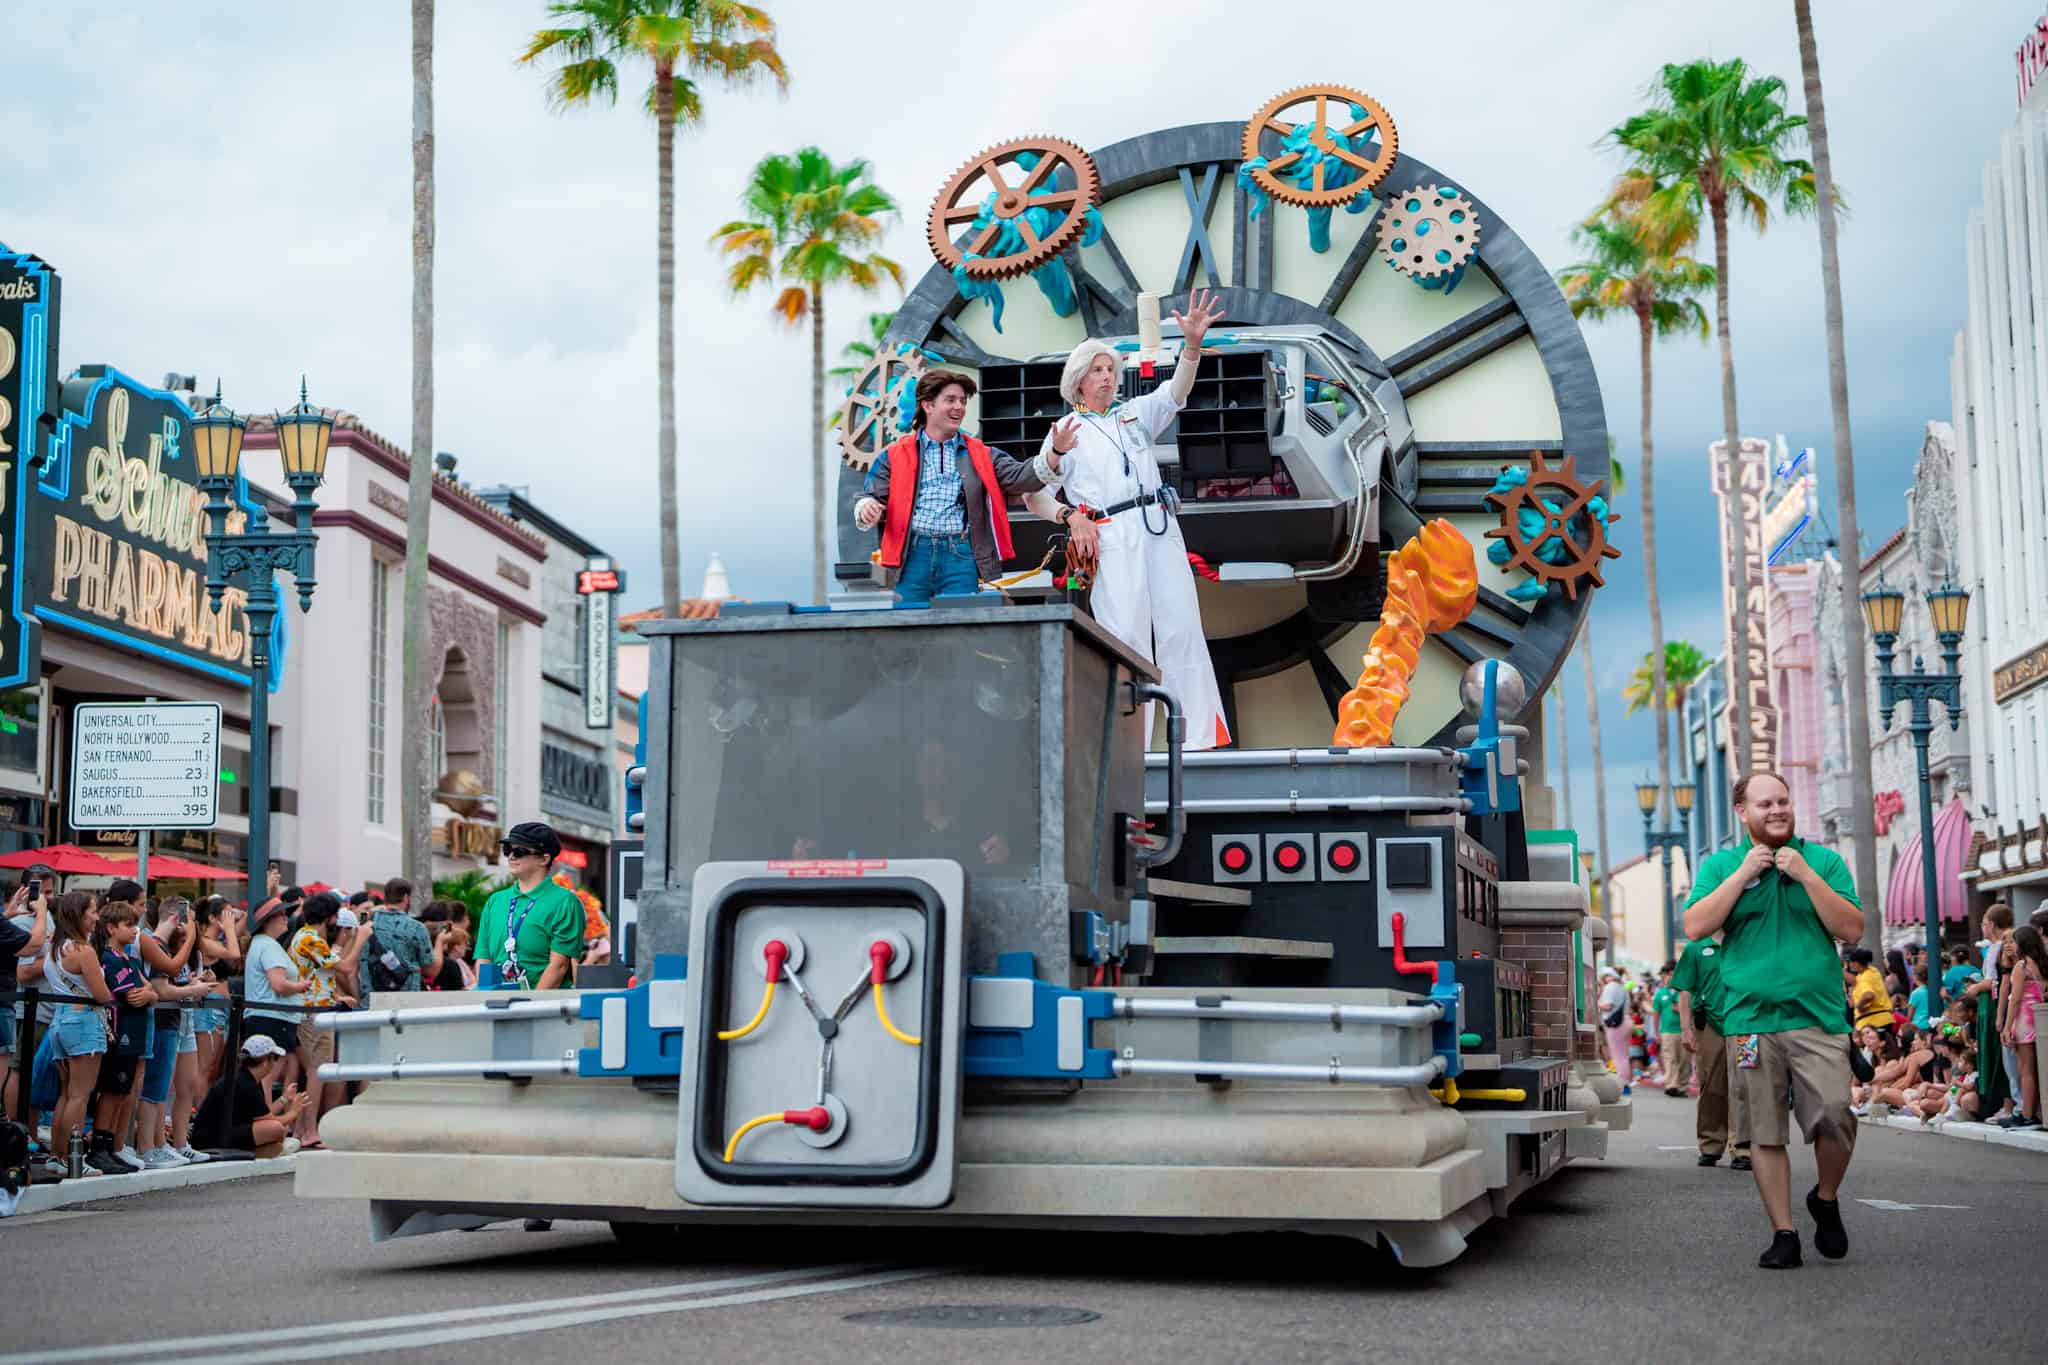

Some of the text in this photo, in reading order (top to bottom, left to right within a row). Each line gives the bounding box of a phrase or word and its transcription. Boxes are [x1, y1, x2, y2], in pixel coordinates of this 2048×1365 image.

[81, 387, 248, 563] Schwa'
[84, 713, 157, 728] UNIVERSAL CITY
[84, 732, 210, 745] NORTH HOLLYWOOD 2
[83, 750, 101, 762] SAN
[105, 749, 152, 762] FERNANDO
[194, 749, 202, 761] 11
[82, 768, 119, 781] SAUGUS
[184, 767, 202, 780] 23
[81, 785, 208, 799] BAKERSFIELD 113
[80, 803, 208, 817] OAKLAND 395
[97, 830, 137, 846] Candy
